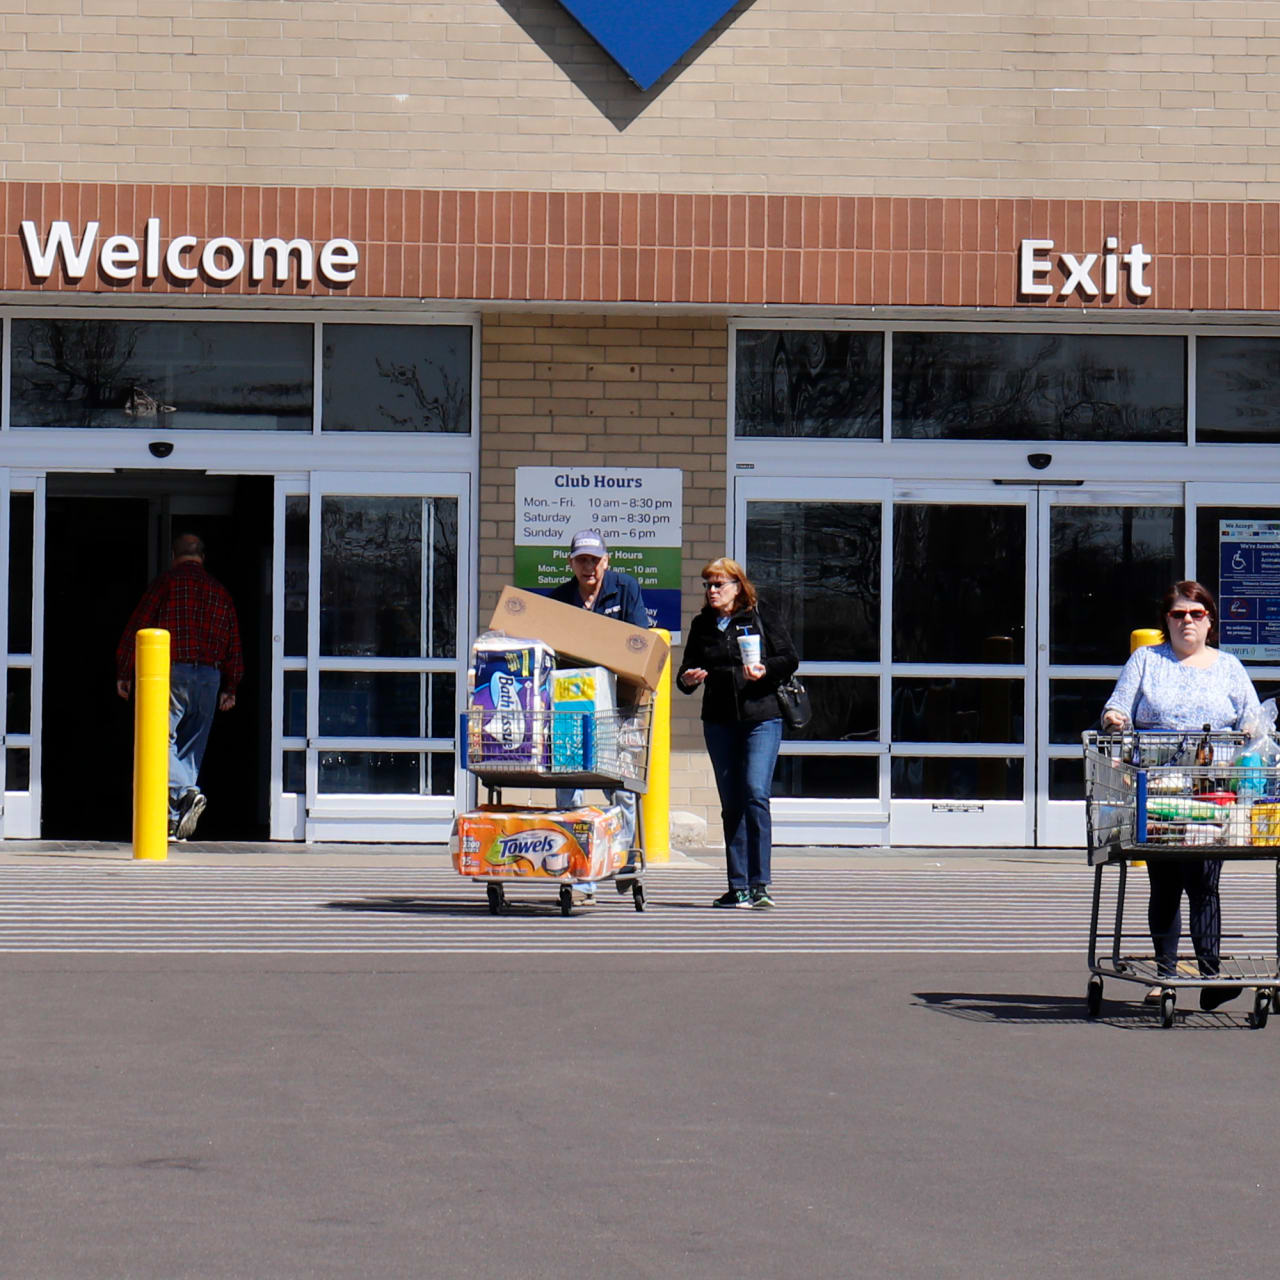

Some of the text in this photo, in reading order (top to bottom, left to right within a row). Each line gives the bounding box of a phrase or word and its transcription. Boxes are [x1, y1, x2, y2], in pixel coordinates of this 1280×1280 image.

[22, 218, 359, 282] Welcome
[1019, 236, 1152, 297] Exit
[554, 474, 643, 488] Club Hours
[523, 497, 550, 508] Mon.
[559, 497, 576, 508] Fri.
[588, 498, 601, 508] 10
[603, 500, 620, 508] am
[629, 498, 653, 508] 8:30
[655, 500, 673, 511] pm
[523, 512, 571, 524] Saturday
[592, 513, 599, 523] 9
[601, 515, 618, 523] am
[627, 513, 651, 523] 8:30
[652, 515, 670, 526] pm
[523, 527, 564, 540] Sunday
[603, 530, 620, 538] am
[629, 528, 637, 538] 6
[638, 530, 656, 541] pm
[614, 550, 643, 559] Hours
[633, 565, 643, 573] 10
[638, 576, 644, 584] 9
[498, 675, 515, 708] Bath
[572, 822, 590, 831] NEW
[499, 835, 555, 859] Towels
